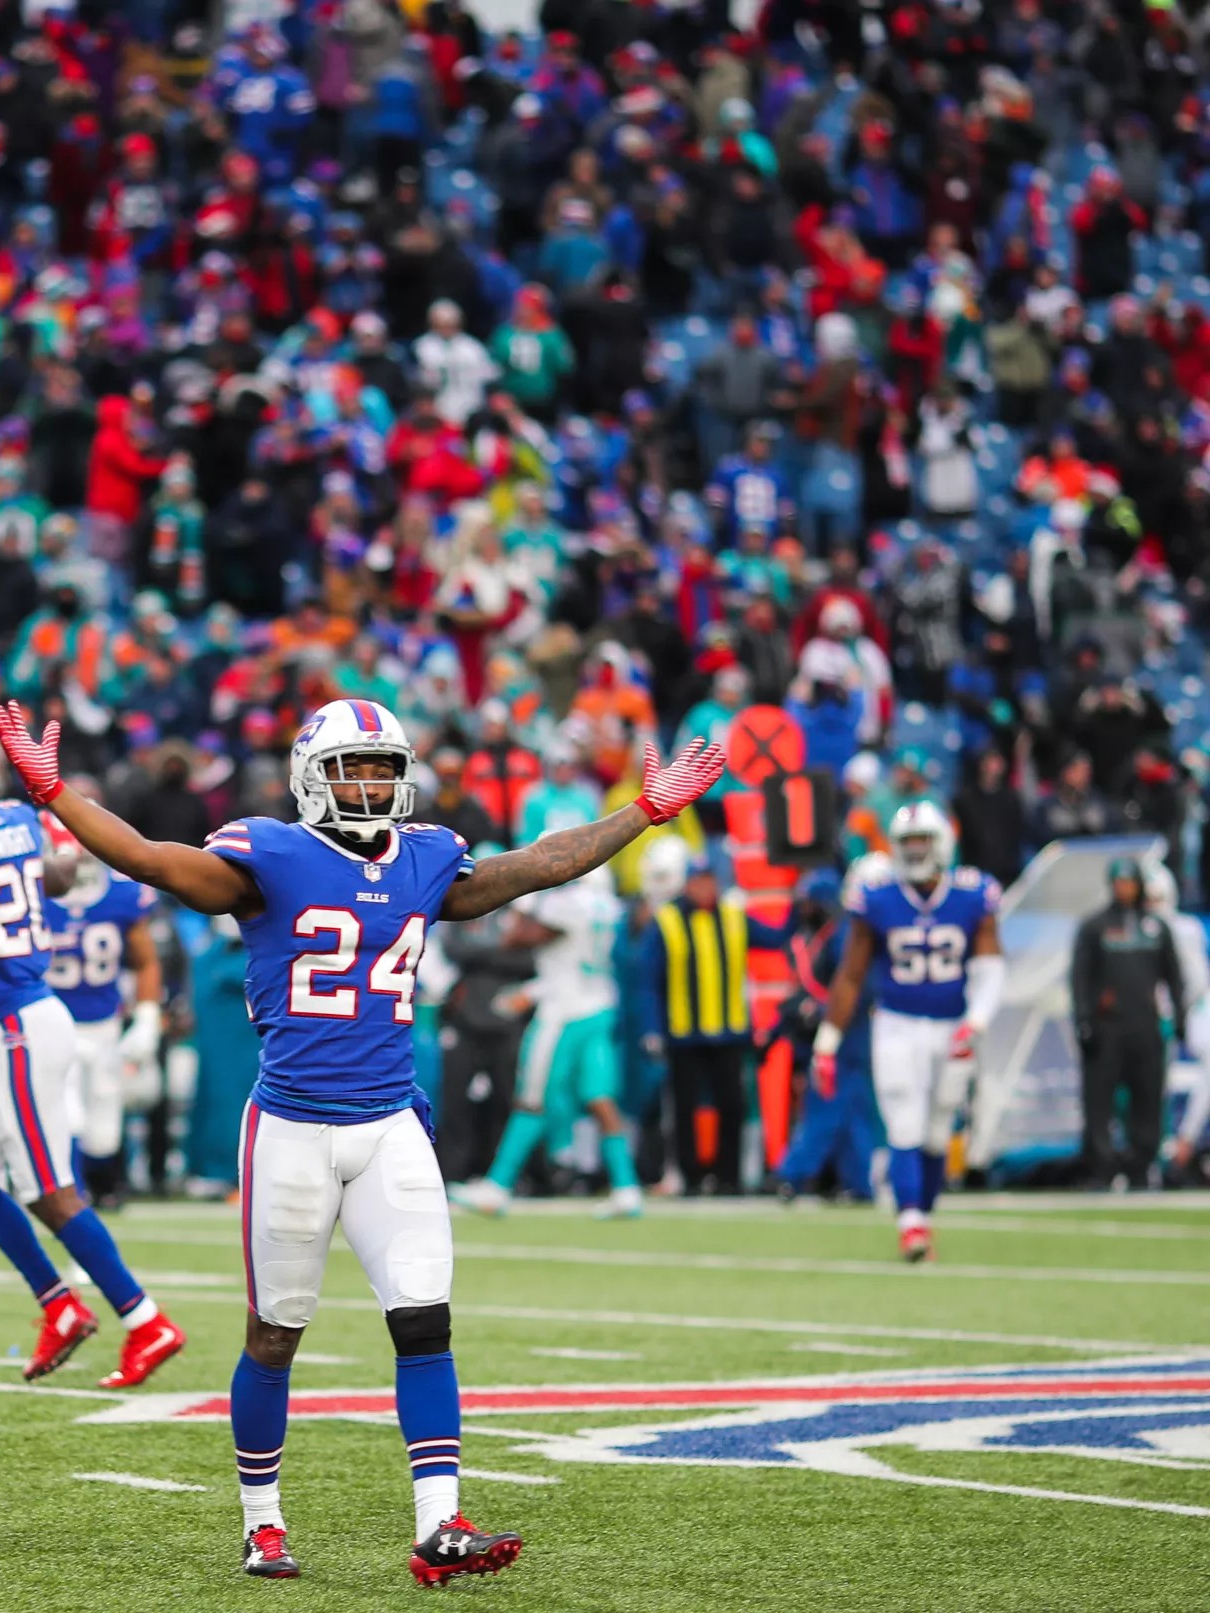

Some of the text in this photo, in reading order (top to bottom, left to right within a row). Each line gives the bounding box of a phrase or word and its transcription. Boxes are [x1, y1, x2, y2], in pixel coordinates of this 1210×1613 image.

[42, 921, 123, 991] 58
[287, 904, 427, 1025] 24
[886, 923, 968, 986] 52
